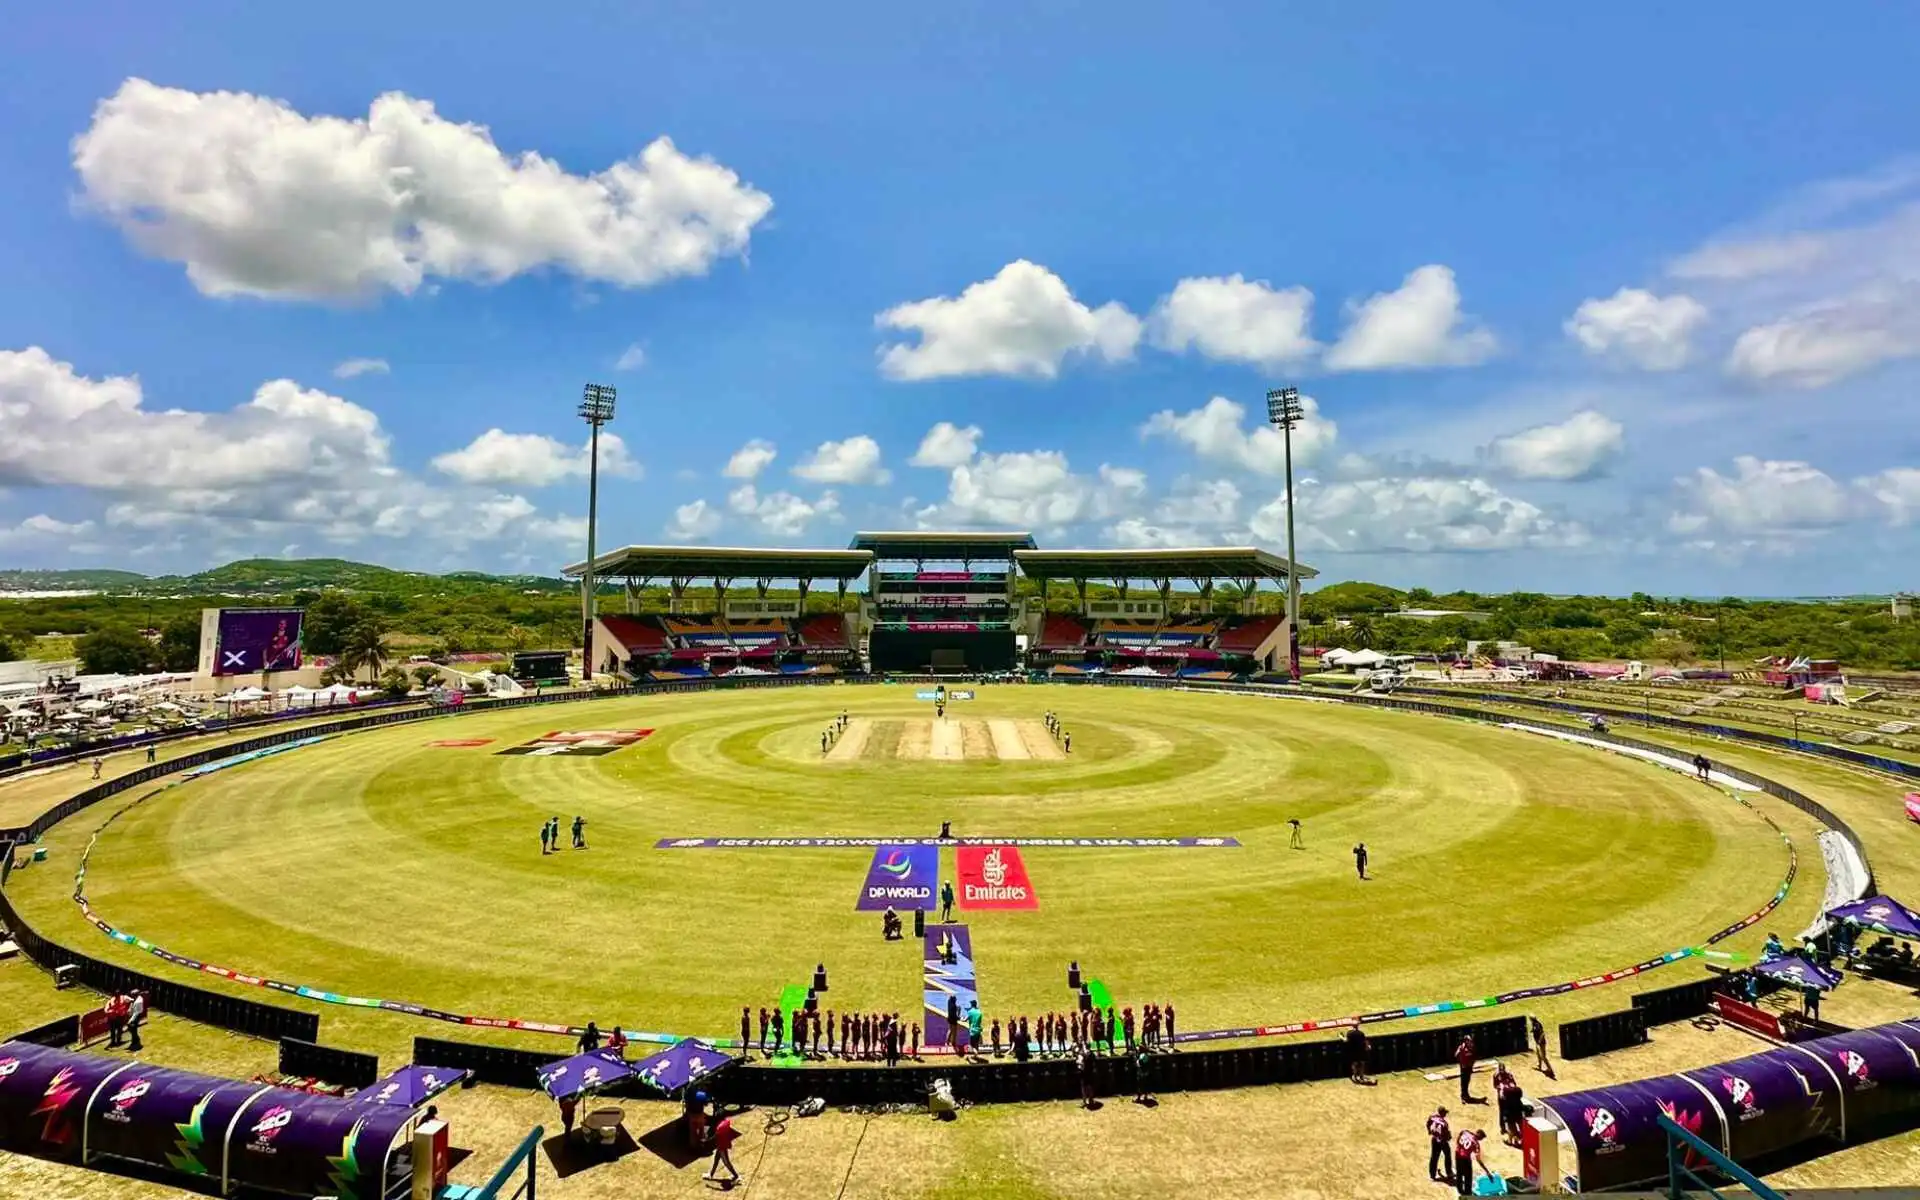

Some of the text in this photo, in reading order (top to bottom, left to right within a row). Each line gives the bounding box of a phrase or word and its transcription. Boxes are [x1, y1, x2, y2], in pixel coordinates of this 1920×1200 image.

[717, 838, 1180, 846] ICC MEN'S T20 WORLD CUP WEST INDIES & USA 2024
[868, 887, 930, 898] DP WORLD
[965, 884, 1026, 900] Emirates
